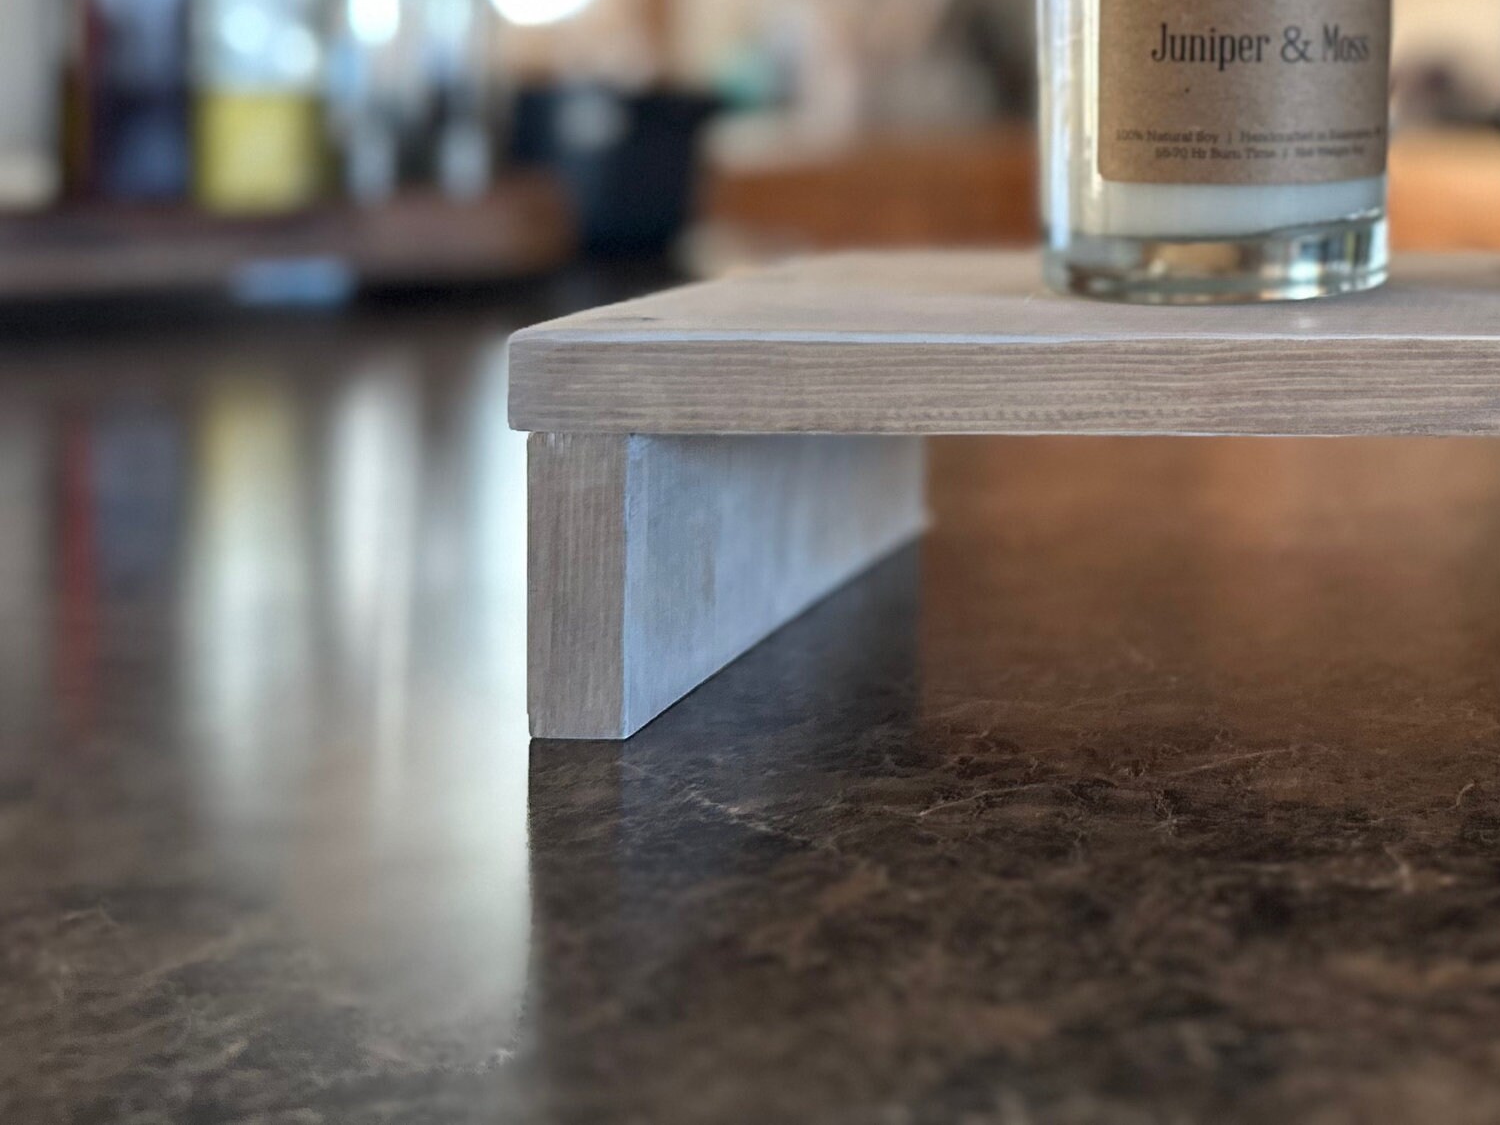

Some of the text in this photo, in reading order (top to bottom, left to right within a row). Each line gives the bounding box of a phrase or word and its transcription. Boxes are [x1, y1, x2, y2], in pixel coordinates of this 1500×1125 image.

[1151, 23, 1369, 70] Juniper & Moss
[1146, 130, 1192, 143] Natural
[1196, 130, 1218, 145] Soy
